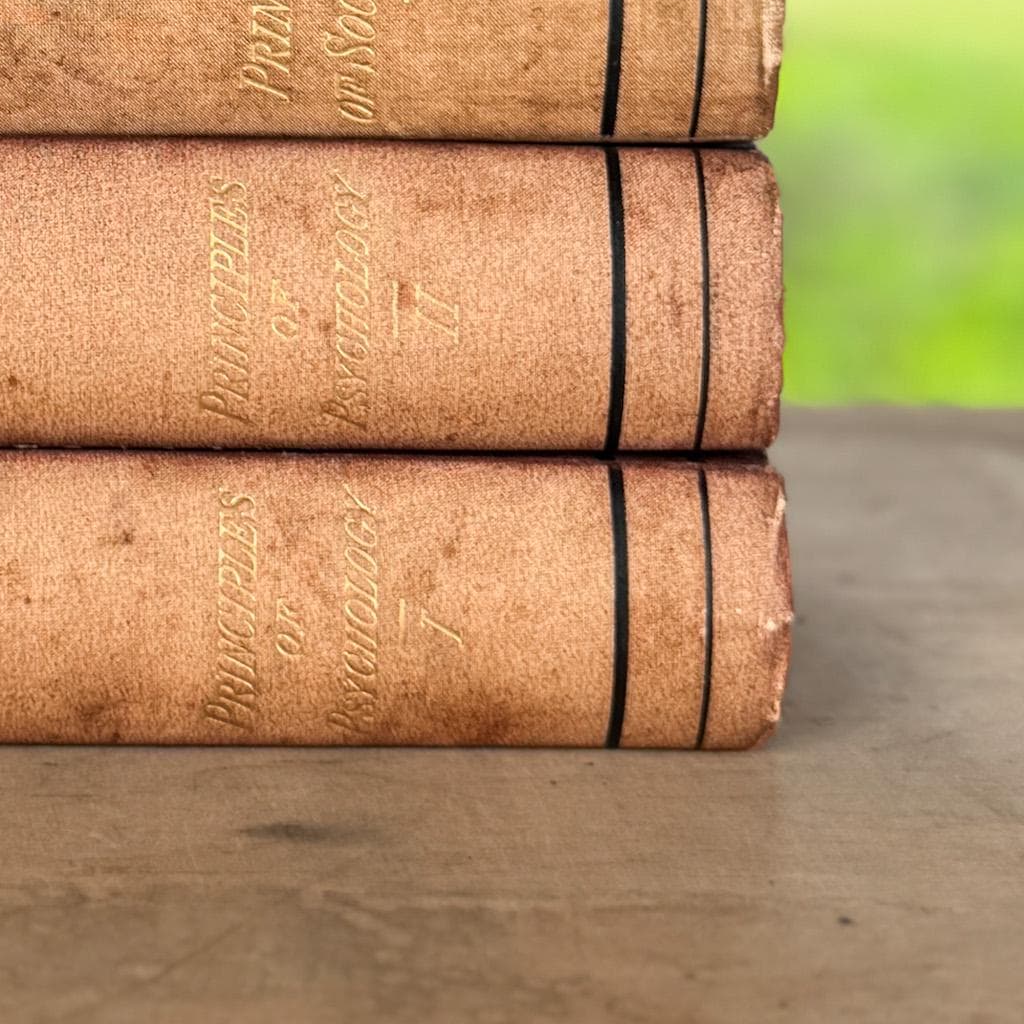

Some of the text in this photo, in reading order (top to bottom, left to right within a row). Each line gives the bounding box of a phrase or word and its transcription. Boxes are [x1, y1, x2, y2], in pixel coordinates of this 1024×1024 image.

[336, 75, 375, 123] OF
[201, 176, 251, 426] PRINCIPLES
[271, 278, 299, 340] OF
[322, 169, 370, 430] PSYCHOLOGY
[416, 283, 460, 346] II
[205, 487, 258, 732] PRINCIPLES
[276, 598, 304, 656] OF
[329, 483, 378, 735] PSYCHOLOGY
